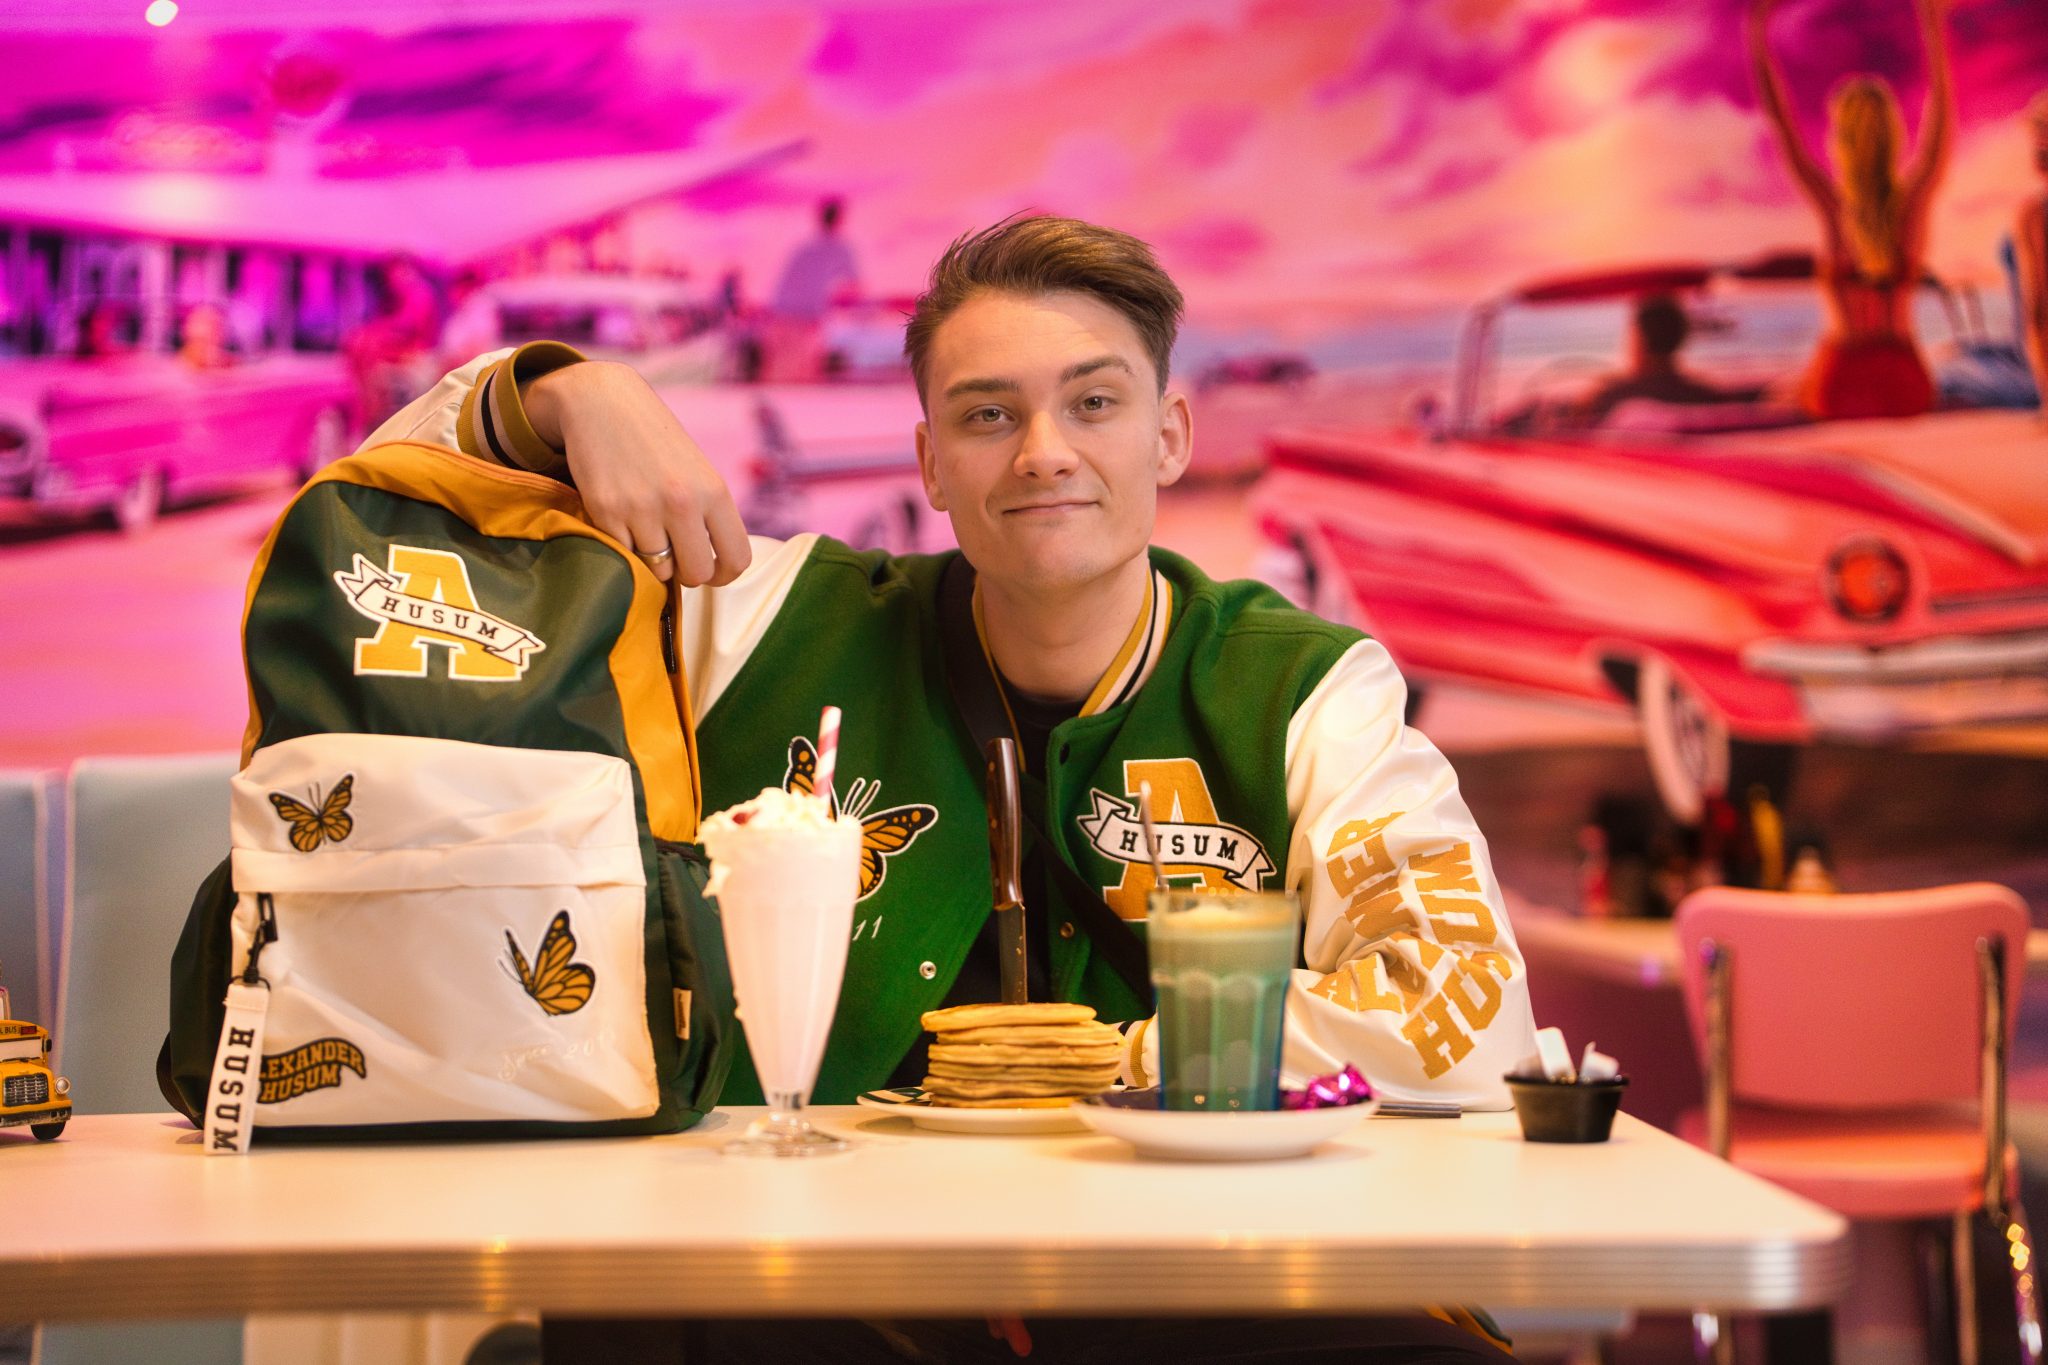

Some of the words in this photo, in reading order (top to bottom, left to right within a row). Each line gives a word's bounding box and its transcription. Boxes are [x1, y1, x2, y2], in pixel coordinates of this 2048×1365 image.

[381, 596, 499, 640] HUSUM
[1119, 829, 1239, 861] HUSUM
[4, 1025, 17, 1034] BUS
[213, 1026, 255, 1152] HUSUM
[261, 1063, 339, 1101] HUSUM
